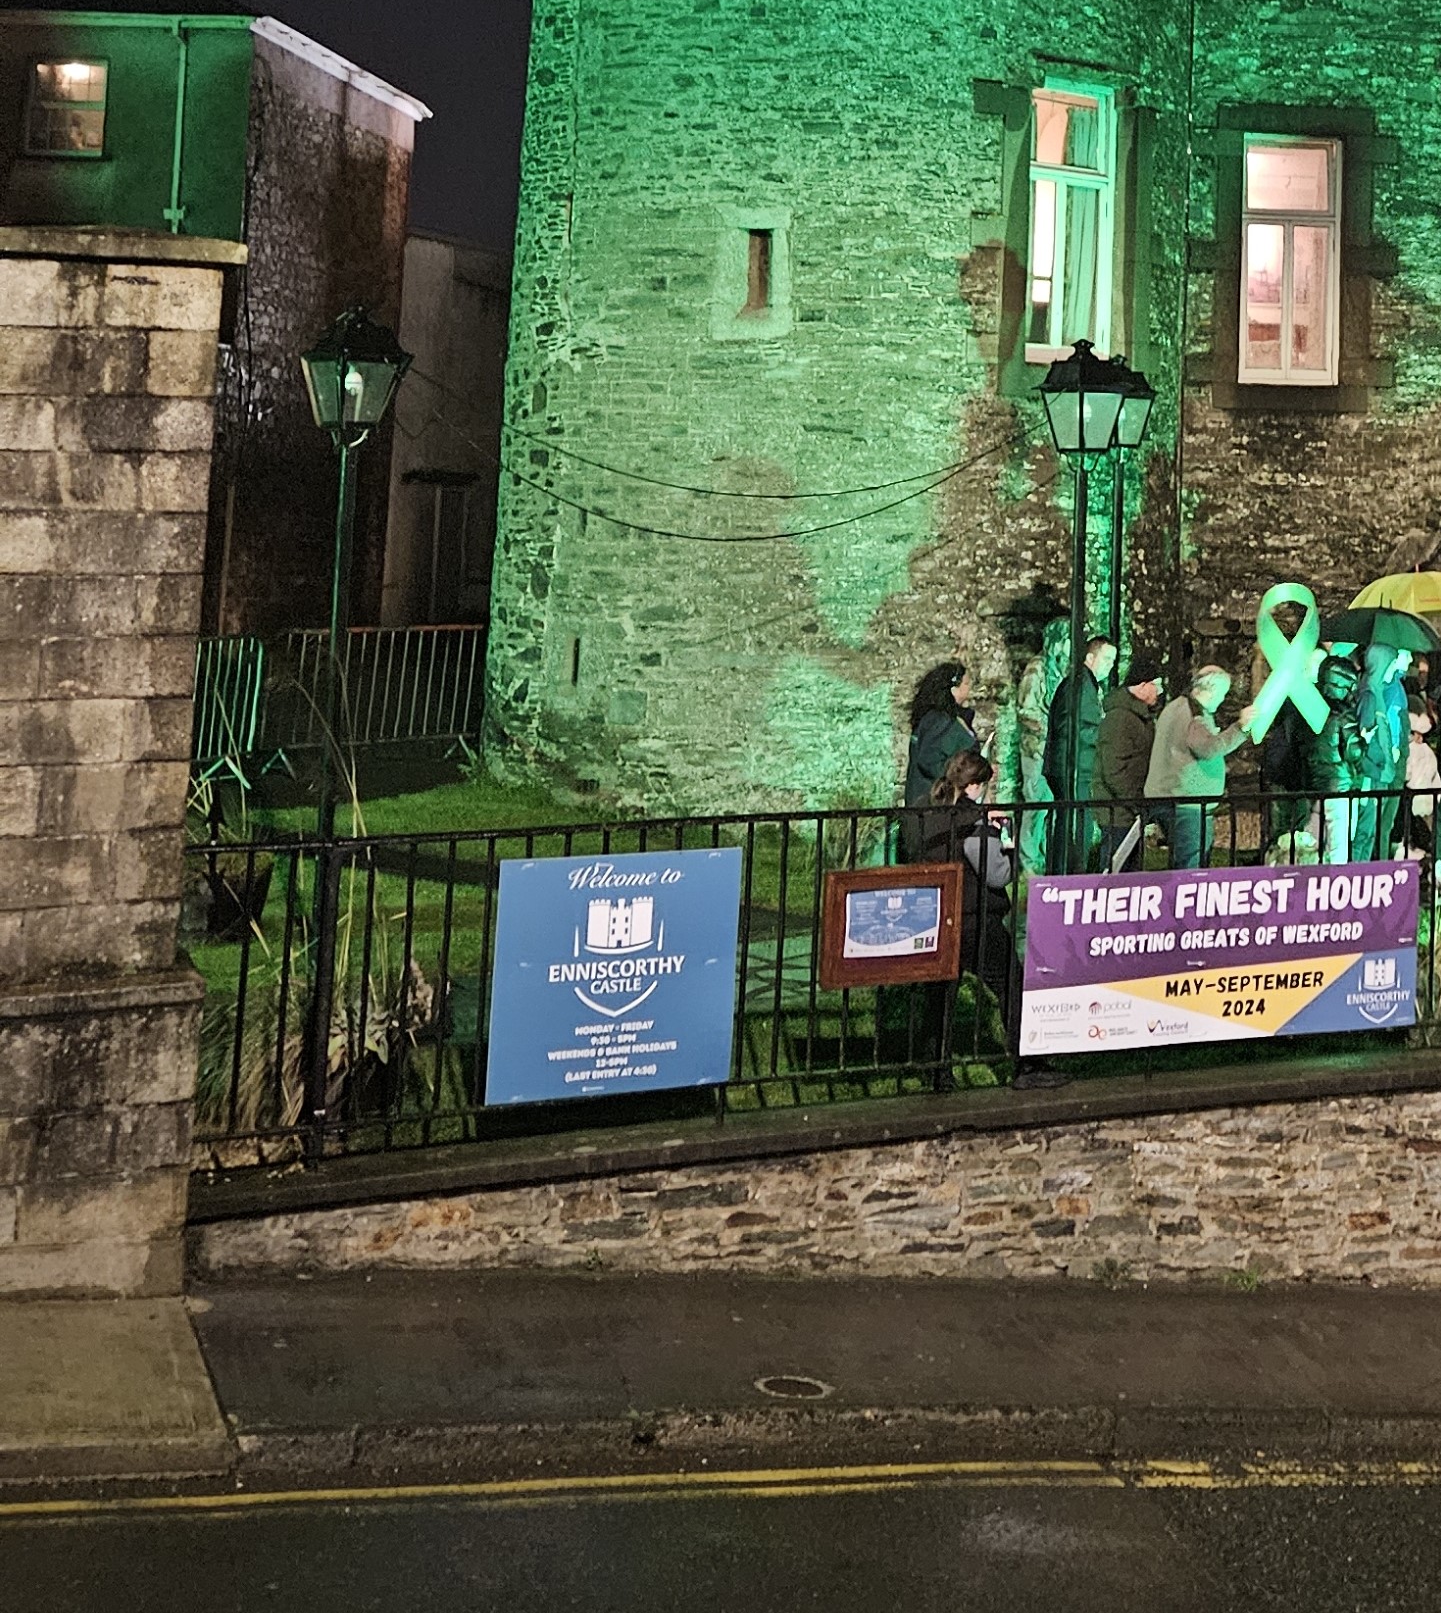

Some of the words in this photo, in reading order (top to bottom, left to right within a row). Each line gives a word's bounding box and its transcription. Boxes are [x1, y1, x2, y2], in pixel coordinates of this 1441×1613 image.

[568, 862, 658, 889] Welcome
[660, 868, 684, 884] to
[1042, 887, 1163, 925] “THEIR
[1175, 878, 1295, 919] FINEST
[1306, 869, 1409, 912] HOUR”
[1089, 932, 1176, 957] SPORTING
[1180, 927, 1250, 950] GREATS
[1255, 925, 1278, 945] OF
[1282, 921, 1364, 944] WEXFORD
[548, 955, 685, 983] ENNISCORTHY
[590, 977, 642, 995] CASTLE
[1346, 990, 1410, 1005] ENNISCORTHY
[1365, 1001, 1391, 1012] CASTLE
[1222, 998, 1266, 1017] 2024
[575, 1023, 615, 1036] MONDAY
[620, 1020, 654, 1032] FRIDAY
[590, 1035, 611, 1046] 9:30
[547, 1048, 597, 1061] WEEKENDS
[605, 1044, 631, 1056] BANK
[631, 1040, 677, 1054] HOLIDAYS
[564, 1071, 591, 1084] (LAST
[591, 1068, 621, 1080] ENTRY
[620, 1067, 633, 1077] AT
